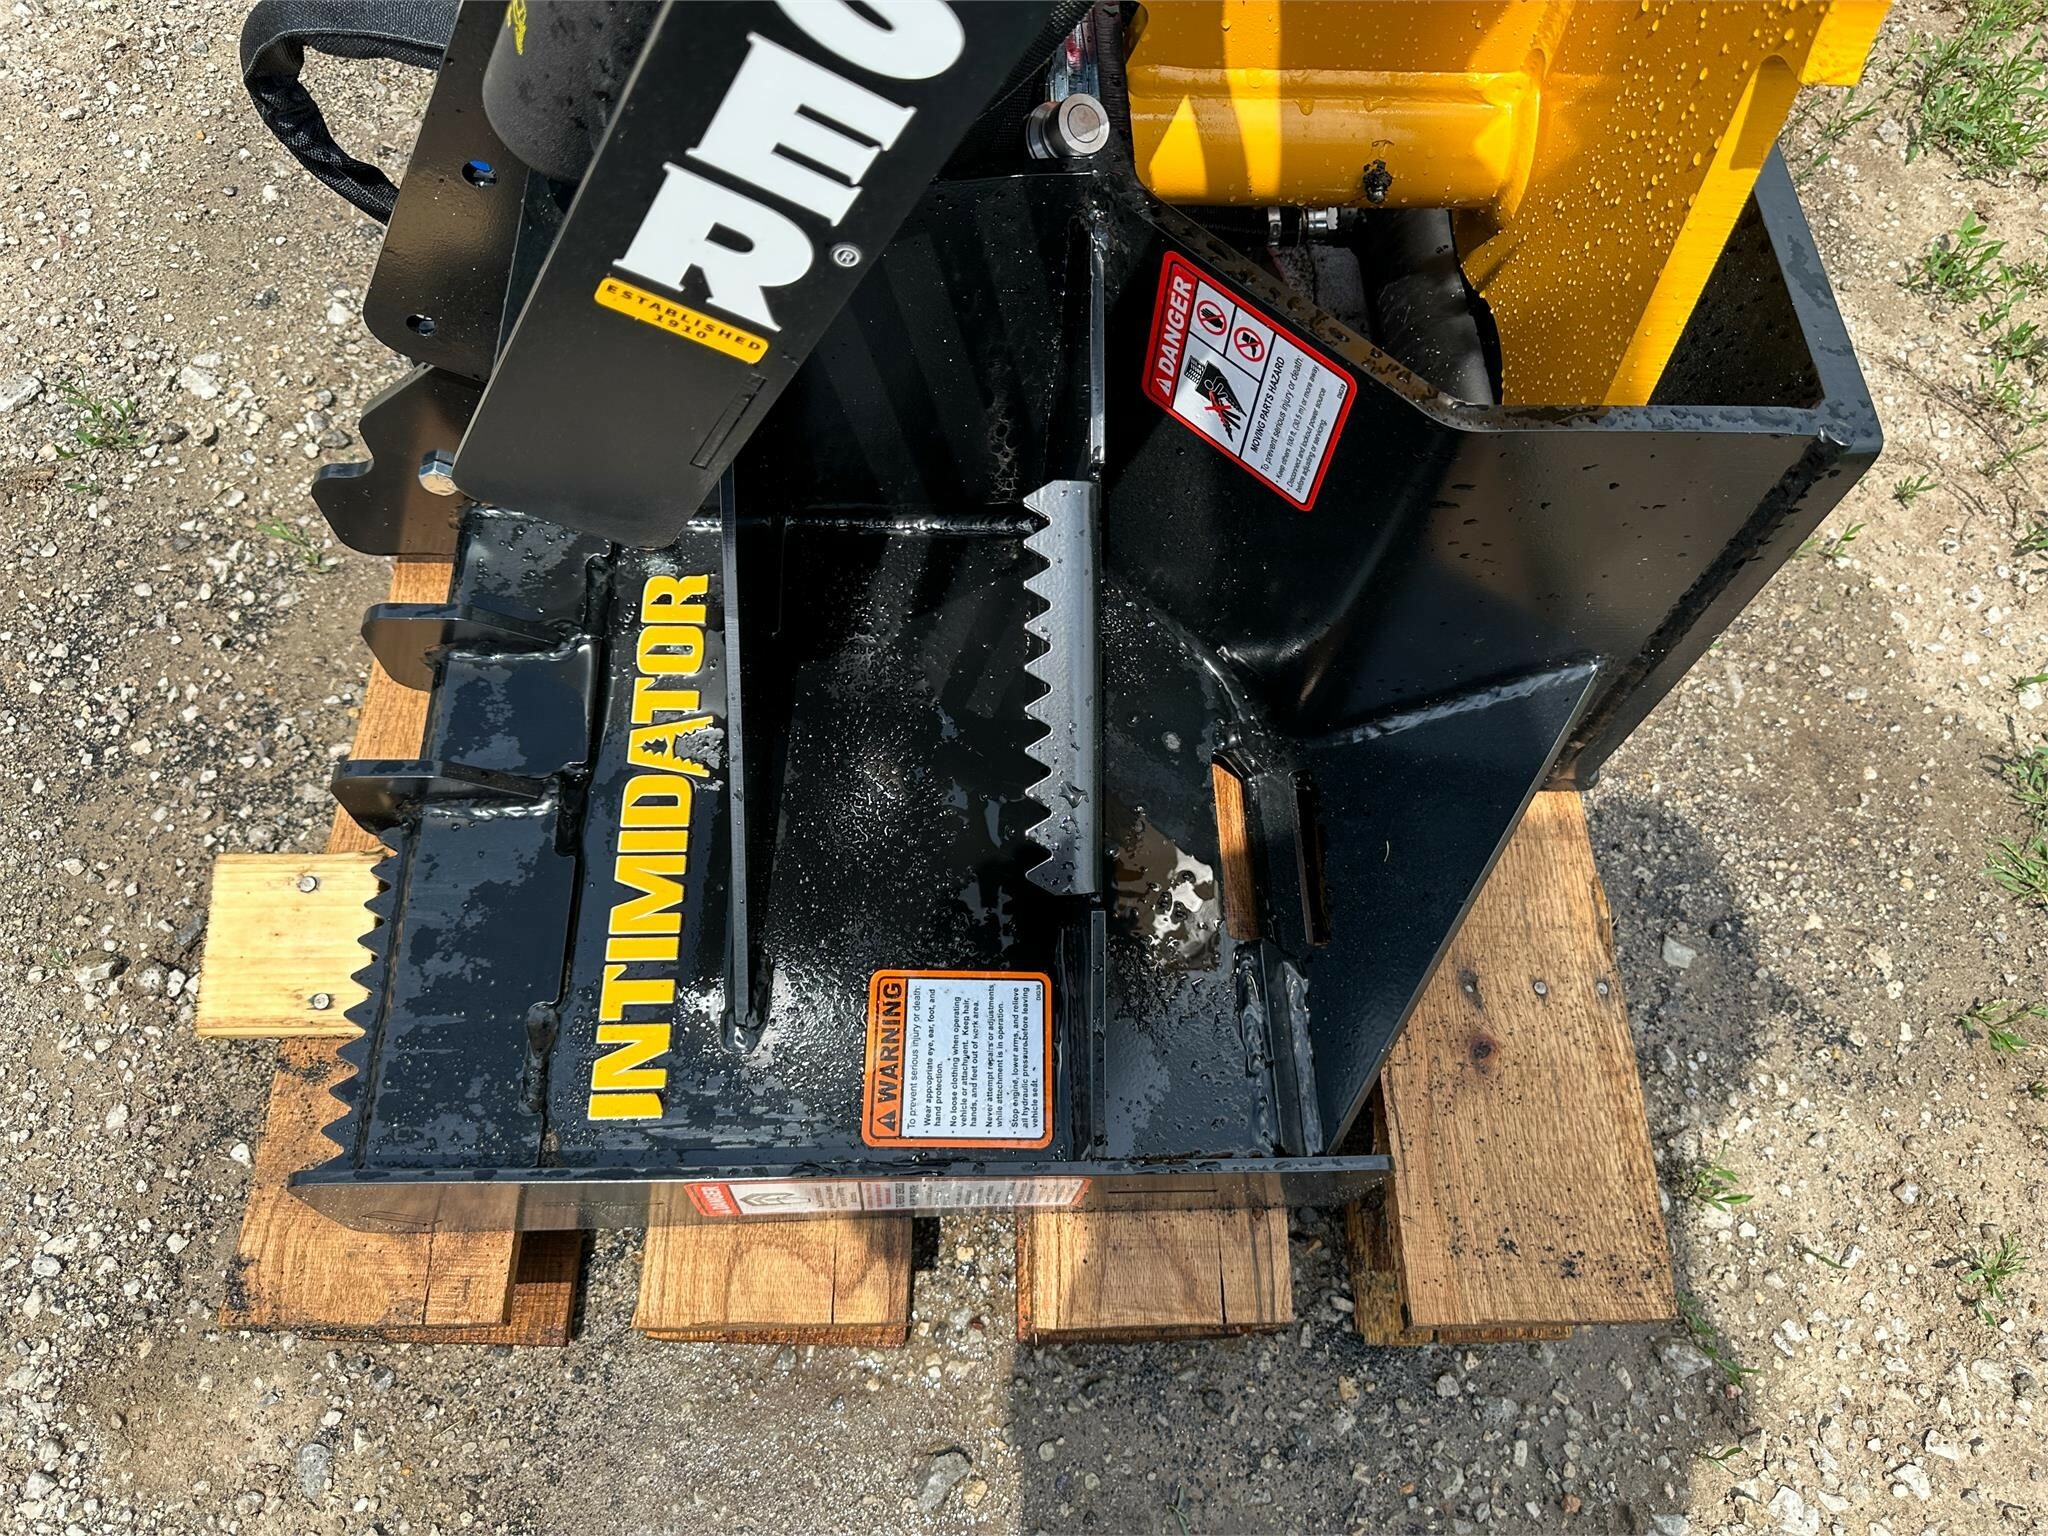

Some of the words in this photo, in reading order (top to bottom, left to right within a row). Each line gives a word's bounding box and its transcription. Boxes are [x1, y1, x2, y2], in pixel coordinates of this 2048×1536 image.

[605, 284, 761, 351] ESTABLISHED
[653, 313, 708, 340] 1910
[1159, 276, 1191, 376] DANGER
[1291, 355, 1303, 380] death:
[1288, 380, 1295, 390] or
[1250, 421, 1265, 453] MOVING
[1260, 393, 1273, 421] PARTS
[1268, 357, 1284, 394] HAZARD
[1280, 390, 1294, 411] injury
[1273, 411, 1286, 437] serious
[1265, 437, 1277, 465] prevent
[588, 573, 714, 1121] INTIMIDATOR
[928, 1005, 936, 1022] foot,
[953, 997, 961, 1032] operating
[1022, 988, 1030, 1014] leaving
[914, 1014, 920, 1022] or
[878, 983, 901, 1103] WARNING
[911, 1025, 920, 1046] injury
[971, 1041, 978, 1049] of
[951, 1057, 959, 1089] clothing
[986, 1072, 994, 1101] attempt
[1022, 1079, 1030, 1116] hydraulic
[907, 1119, 916, 1129] To
[950, 1116, 957, 1127] No
[970, 1100, 978, 1127] hands,
